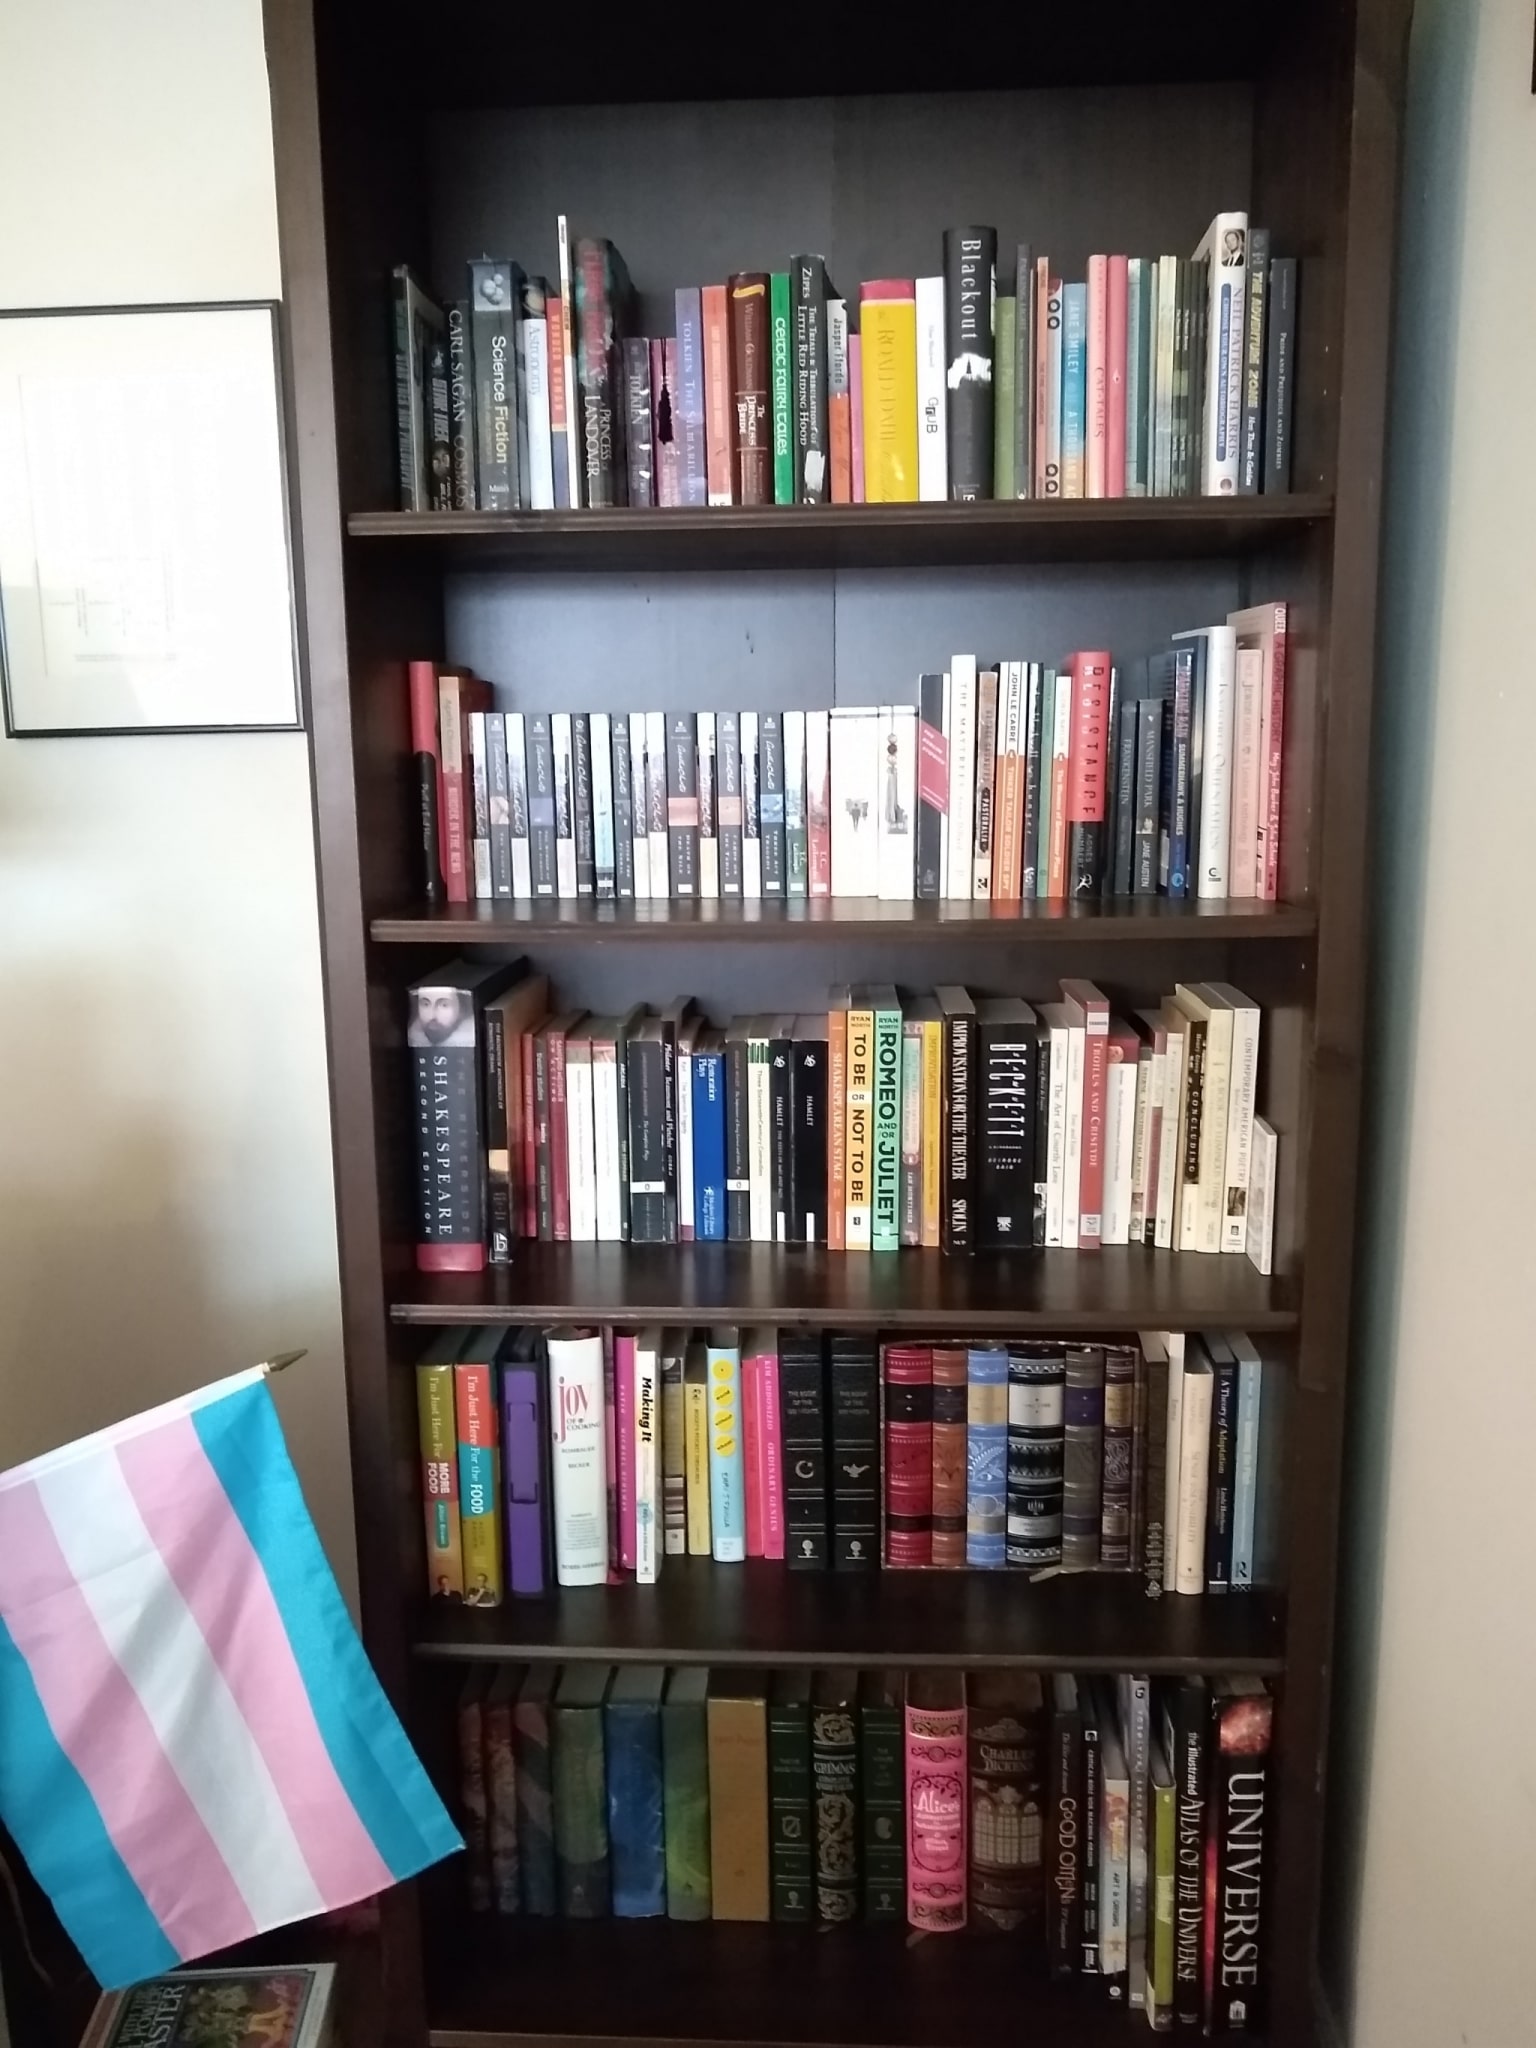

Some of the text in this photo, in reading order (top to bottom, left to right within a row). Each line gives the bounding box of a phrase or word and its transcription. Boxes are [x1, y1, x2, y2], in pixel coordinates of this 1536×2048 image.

[802, 267, 813, 298] ZIPES
[960, 239, 982, 340] Blackout
[745, 303, 754, 341] WILLIAM
[809, 306, 817, 325] THE
[1068, 299, 1079, 374] JANE SMILEY
[528, 324, 541, 396] Astronomy
[683, 322, 693, 373] TOLKIEN
[832, 318, 844, 384] Jasper Fforde
[1248, 271, 1262, 409] THE ADVENTURE ZONE
[1279, 332, 1287, 355] PRIDE
[798, 305, 808, 446] LITTLE RED RIDING HOOD
[1220, 356, 1228, 376] OWN
[1228, 287, 1243, 458] NEIL PATRICK HARRIS
[449, 309, 467, 507] CARL SAGAN COSMOS
[492, 336, 509, 463] Science Fiction
[685, 380, 696, 405] THE
[810, 369, 818, 432] TRIBULATIONS
[1218, 379, 1227, 447] AUTOBIOGRAPHY
[1277, 376, 1285, 415] PREJUDICE
[583, 395, 601, 478] LANDOVER
[600, 409, 611, 460] PRINCESS
[738, 403, 747, 435] BRIDE
[746, 396, 756, 446] PRINCESS
[1247, 416, 1256, 450] Here There
[1067, 423, 1077, 479] THOUSAND
[1275, 435, 1284, 469] ZOMBIES
[1274, 608, 1285, 634] QUEER
[1273, 650, 1282, 696] GRAPHIC
[1010, 700, 1017, 711] LE
[1273, 700, 1282, 742] HISTORY
[1121, 739, 1131, 804] FRANKENSTEIN
[1145, 730, 1154, 782] MANSFIELD
[1176, 744, 1186, 797] SUMMERHAWK
[1006, 767, 1014, 799] TINKER
[1144, 785, 1153, 807] PARK
[981, 799, 989, 842] PASTORALIA
[1005, 802, 1013, 832] TAILOR
[1176, 806, 1184, 836] HUGHES
[1004, 835, 1012, 872] SOLDIER
[1141, 860, 1150, 886] AUSTEN
[1002, 875, 1010, 891] SPY
[696, 1058, 707, 1078] Plays
[854, 1034, 866, 1057] TO
[708, 1058, 716, 1101] Restoration
[854, 1063, 865, 1085] BE
[879, 1032, 897, 1120] ROMEO
[987, 1043, 1027, 1136] BECKETT
[776, 1096, 784, 1126] HAMLET
[833, 1053, 843, 1182] SHAKESPEAREAN STAGE
[853, 1109, 864, 1144] NOT
[951, 1020, 967, 1232] IMPROVISATION FOR THE THEATER SPOLIN
[1054, 1083, 1063, 1129] The Art of
[1089, 1040, 1103, 1168] TROILUS AND CRISEYDE
[1238, 1037, 1253, 1182] CONTEMPORARY AMERICAN POETRY
[419, 1058, 431, 1234] SECOND EDITION
[434, 1055, 452, 1236] SHAKESPEARE
[457, 1057, 469, 1234] THE RIVERSIDE
[882, 1131, 895, 1139] OR
[1189, 1091, 1199, 1173] CONCLUDING
[852, 1148, 864, 1173] TO
[878, 1141, 894, 1224] JULIET
[852, 1180, 863, 1201] BE
[430, 1395, 439, 1416] Just
[554, 1376, 588, 1444] joy
[639, 1377, 652, 1442] Making It
[1217, 1419, 1228, 1427] of
[1219, 1388, 1229, 1416] Theory
[432, 1418, 441, 1441] Here
[433, 1443, 442, 1457] For
[467, 1375, 483, 1514] I'm Just Here For the FOOD
[1218, 1429, 1227, 1474] Adaptation
[428, 1462, 438, 1494] FOOD
[439, 1462, 450, 1494] MORE
[767, 1442, 776, 1493] ORDINARY
[769, 1496, 777, 1531] GENIUS
[1059, 1798, 1077, 1847] GOOD
[1179, 1796, 1205, 1843] ATLAS
[1179, 1849, 1199, 1869] OF
[1221, 1770, 1265, 1988] UNIVERSE
[1178, 1874, 1199, 1901] THE
[1176, 1907, 1201, 1982] UNIVERSE
